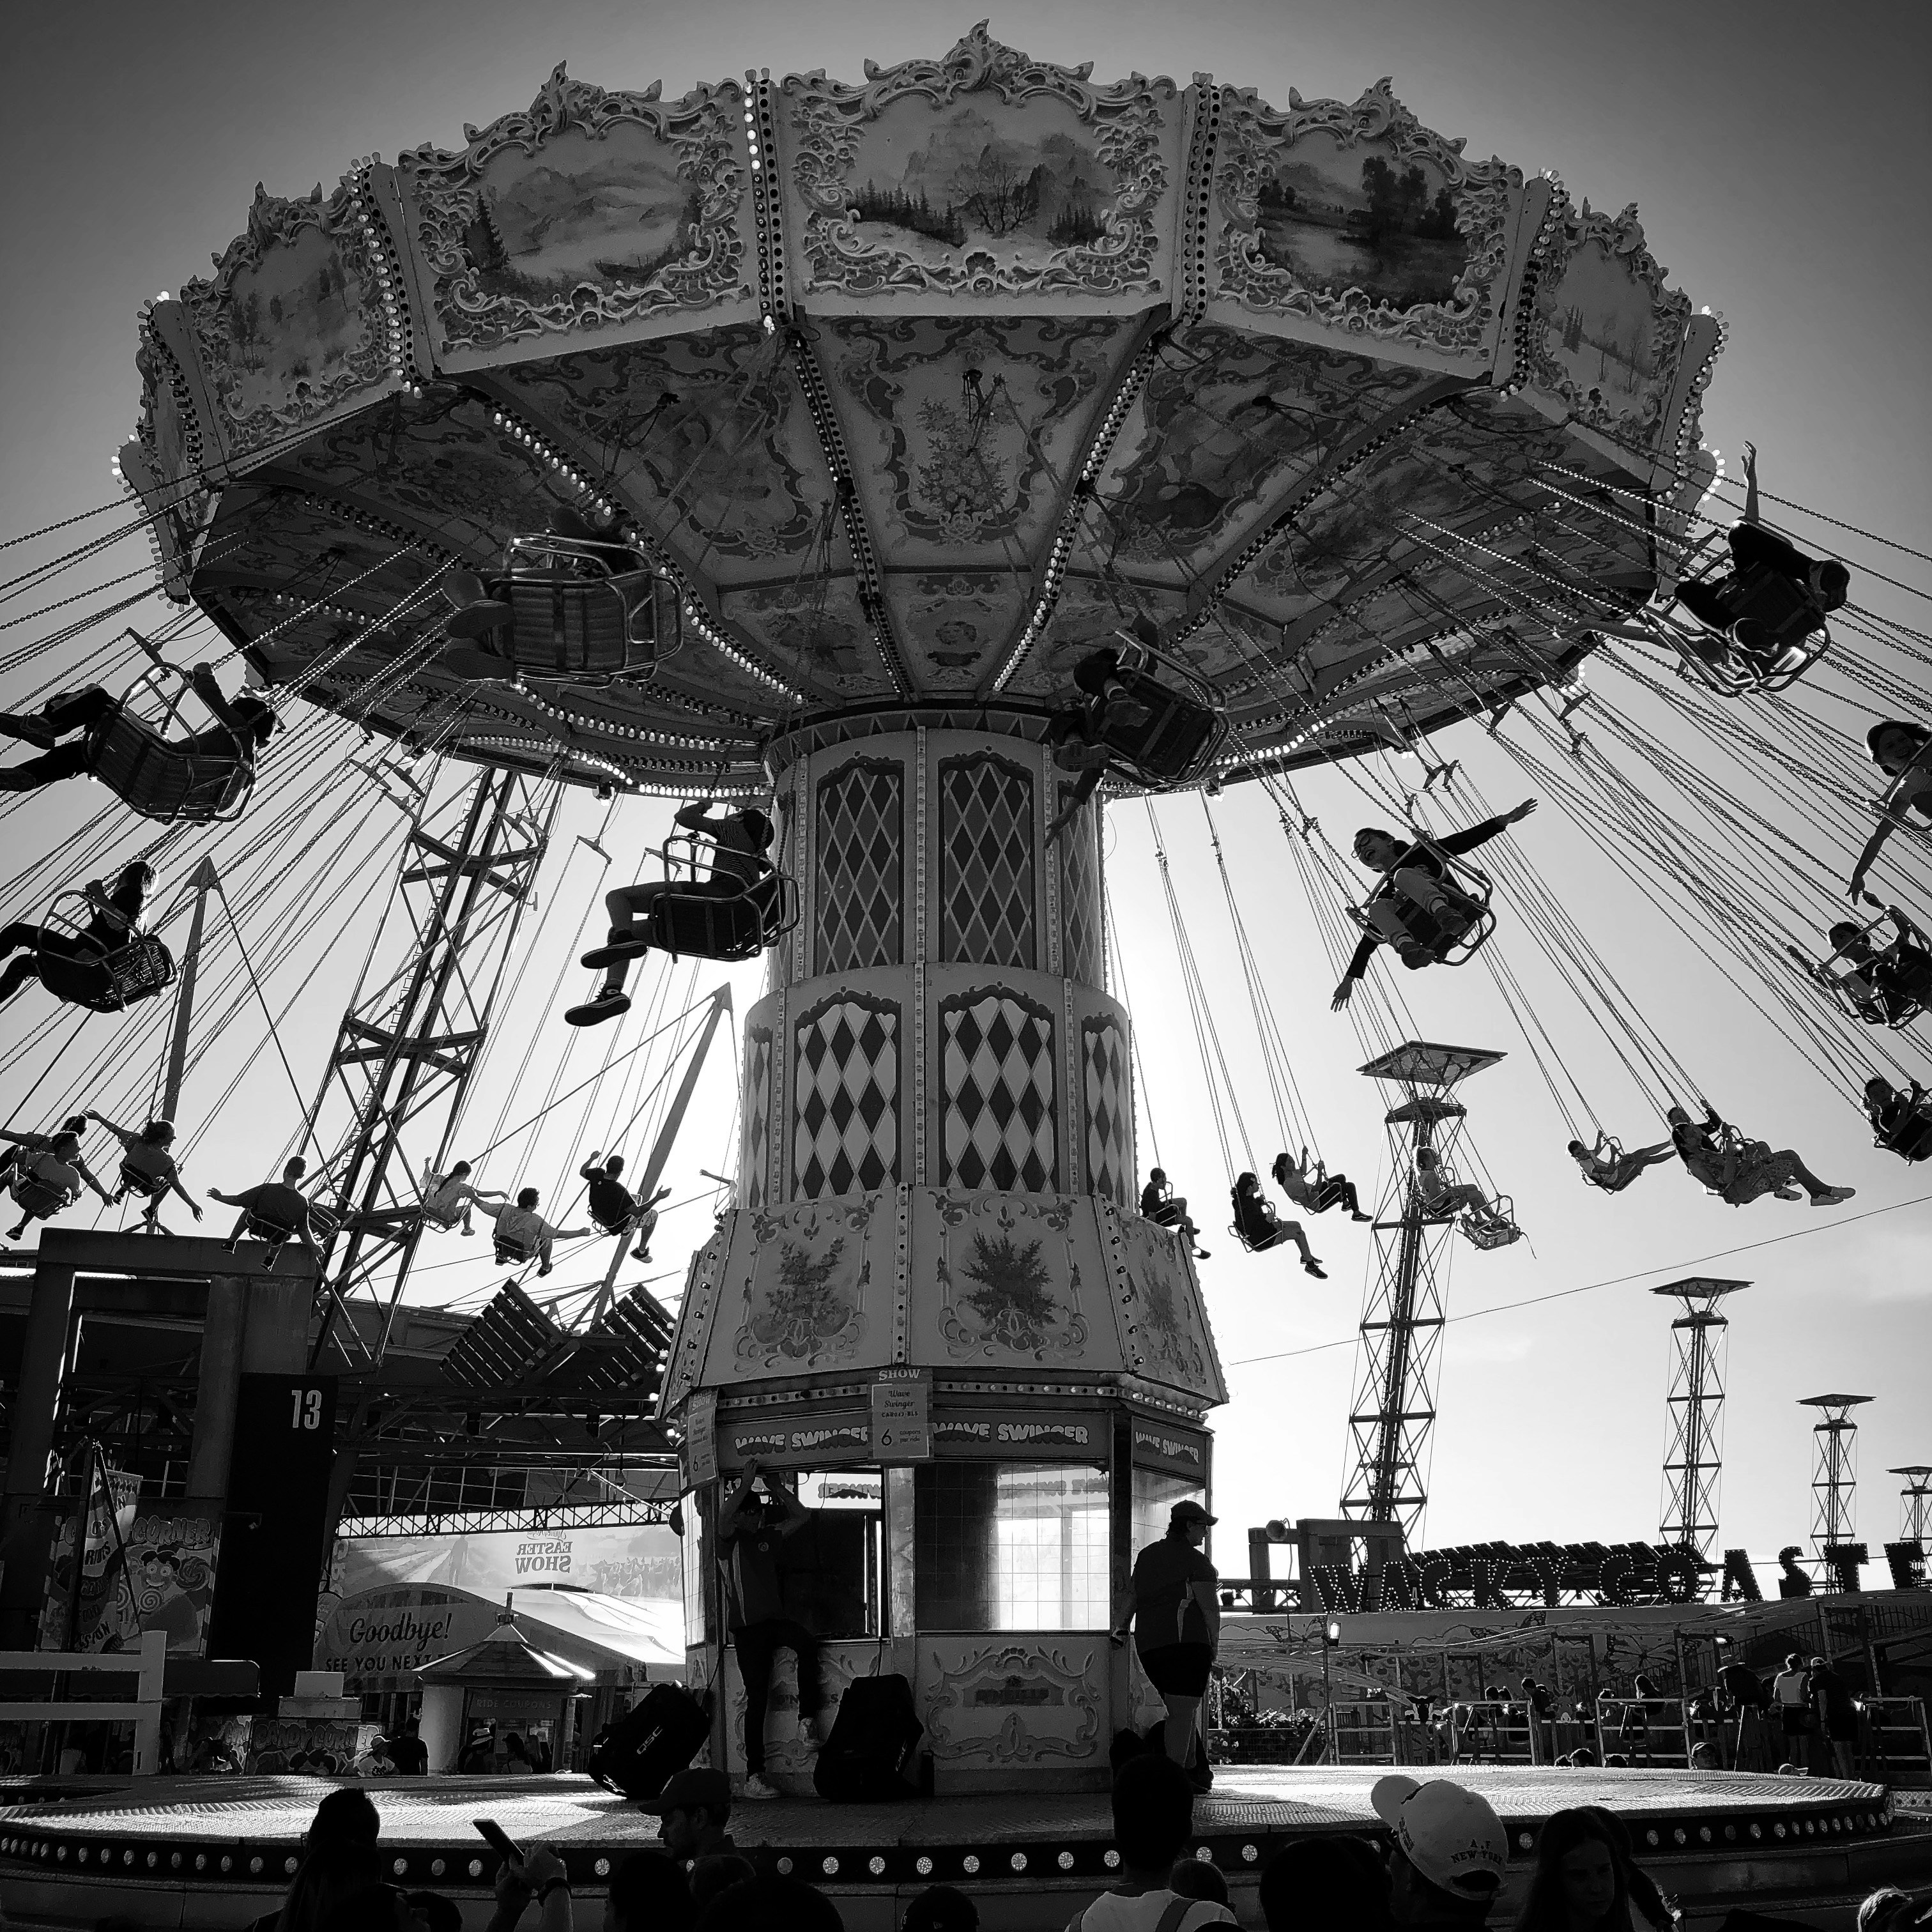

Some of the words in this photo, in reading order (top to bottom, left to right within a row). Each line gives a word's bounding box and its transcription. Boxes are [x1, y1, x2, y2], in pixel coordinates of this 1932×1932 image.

[879, 1368, 921, 1381] SHOW
[291, 1390, 322, 1429] 13
[884, 1400, 916, 1409] Swinger
[735, 1433, 786, 1455] WAVE
[881, 1428, 893, 1446] 6
[997, 1423, 1089, 1445] SWINGER
[1135, 1431, 1160, 1455] WAVE
[1163, 1439, 1199, 1465] SWINGER
[693, 1455, 699, 1472] 6
[132, 1515, 212, 1545] CORNER
[1308, 1556, 1569, 1613] WACKY
[350, 1612, 452, 1652] Goodbye!
[326, 1658, 349, 1673] SEE
[354, 1657, 387, 1672] YOU
[477, 1699, 498, 1708] RIDE
[503, 1699, 552, 1710] COUPONS
[255, 1721, 313, 1751] CANDY
[1450, 1850, 1477, 1864] NEW
[1482, 1850, 1502, 1866] YORK
